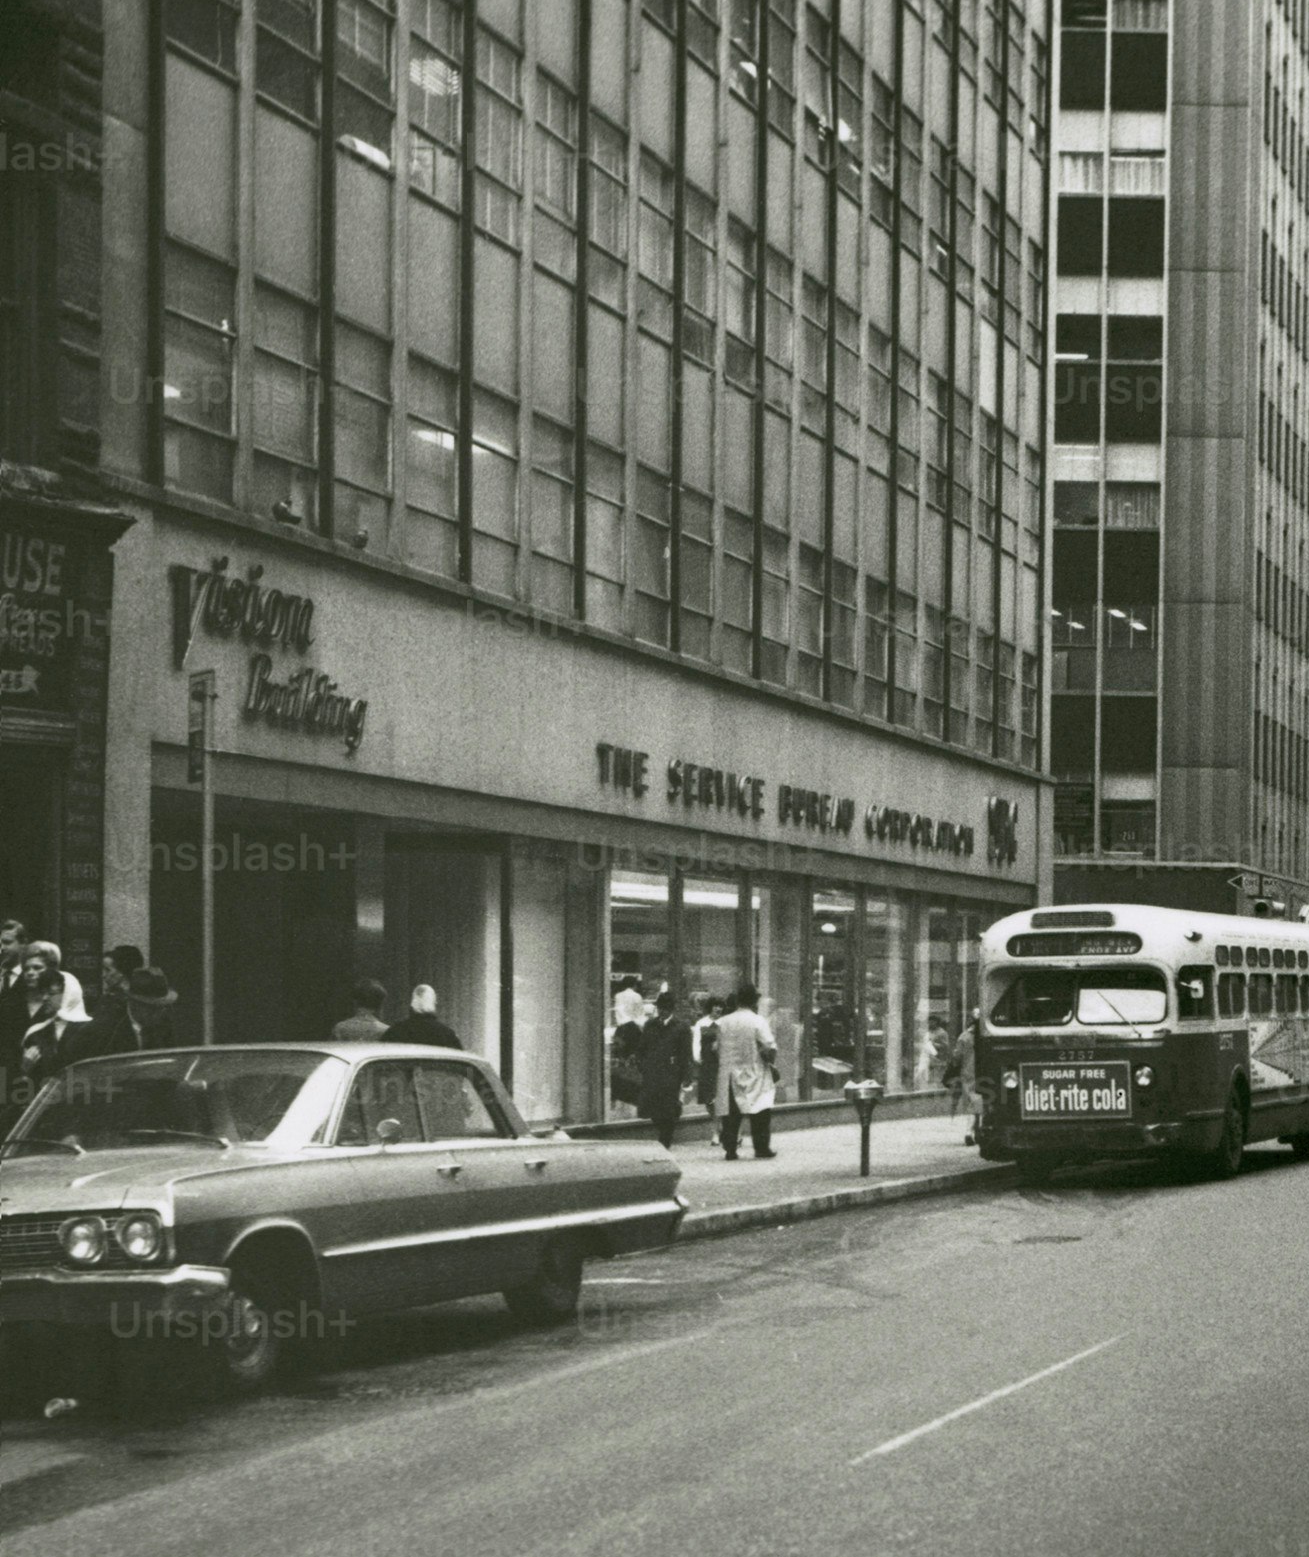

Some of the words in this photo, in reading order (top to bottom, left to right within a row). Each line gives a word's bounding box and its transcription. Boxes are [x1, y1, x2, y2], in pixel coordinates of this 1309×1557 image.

[168, 555, 315, 670] Vision
[243, 653, 368, 750] Building
[597, 743, 649, 797] THE
[667, 758, 765, 820] SERVICE
[1024, 1080, 1089, 1112] diet-rite
[1092, 1078, 1127, 1111] cola
[1042, 1069, 1075, 1079] SUGAR
[1080, 1069, 1106, 1079] FREE
